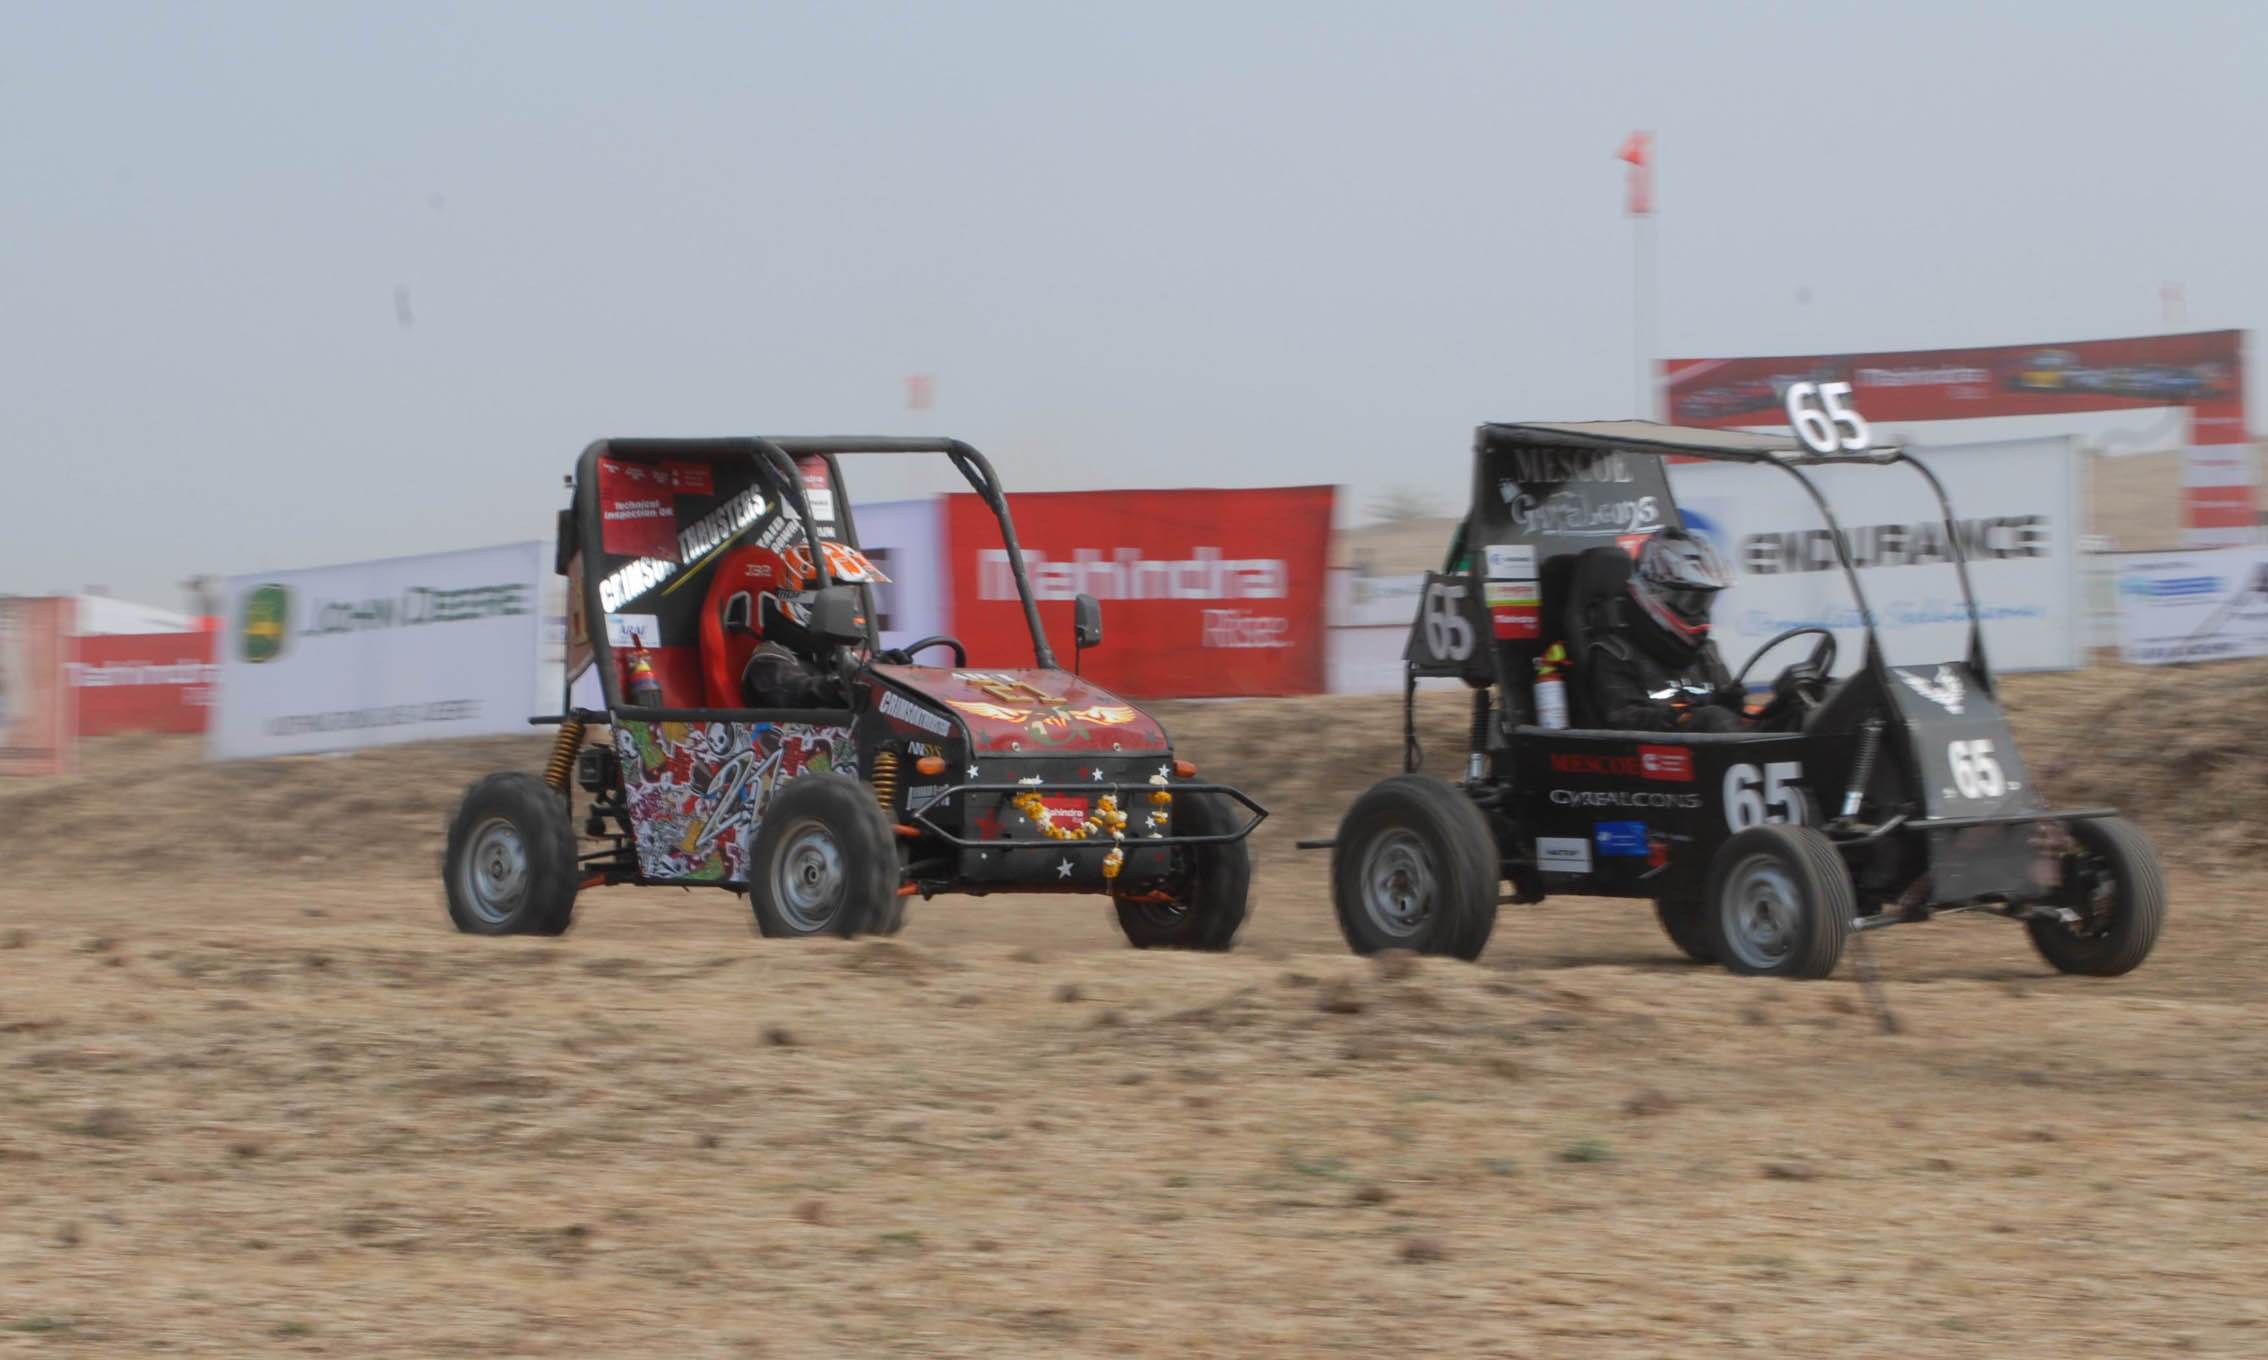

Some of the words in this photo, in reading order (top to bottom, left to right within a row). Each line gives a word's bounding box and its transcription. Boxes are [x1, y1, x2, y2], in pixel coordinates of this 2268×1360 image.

[1786, 381, 1871, 453] 65
[976, 546, 1290, 601] Mahindra
[1424, 582, 1475, 661] 65
[1722, 760, 1804, 835] 65
[1947, 739, 2006, 799] 65
[1049, 807, 1084, 818] ahindra
